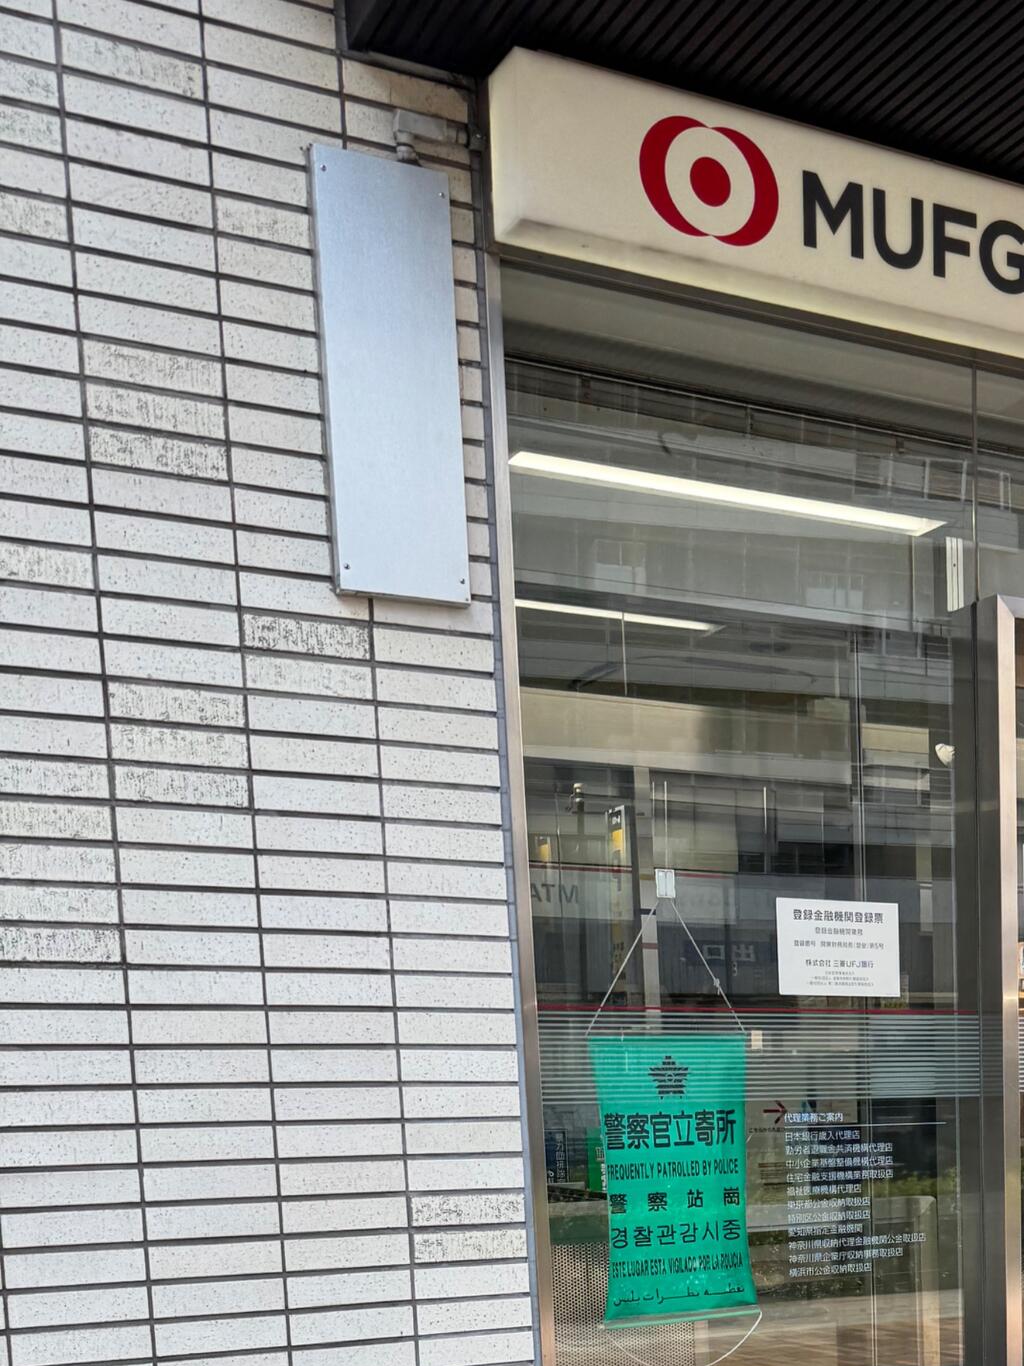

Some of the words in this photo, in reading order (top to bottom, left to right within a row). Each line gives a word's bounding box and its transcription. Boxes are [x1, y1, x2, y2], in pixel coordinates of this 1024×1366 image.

[793, 908, 883, 924] 登録金融機関登録票
[604, 1109, 737, 1150] 警察官立寄所
[784, 1112, 844, 1124] 代理業務ご案内
[607, 1162, 655, 1181] FREQUENTLY
[658, 1160, 700, 1178] PATROLLED
[703, 1159, 712, 1176] BY
[714, 1158, 739, 1175] POLICE
[611, 1219, 741, 1249] 경찰관감시중
[612, 1261, 627, 1278] ESTE
[627, 1259, 649, 1277] LUGAR
[650, 1258, 666, 1276] ESTA
[669, 1256, 697, 1274] VIGILADO
[699, 1254, 710, 1271] POR
